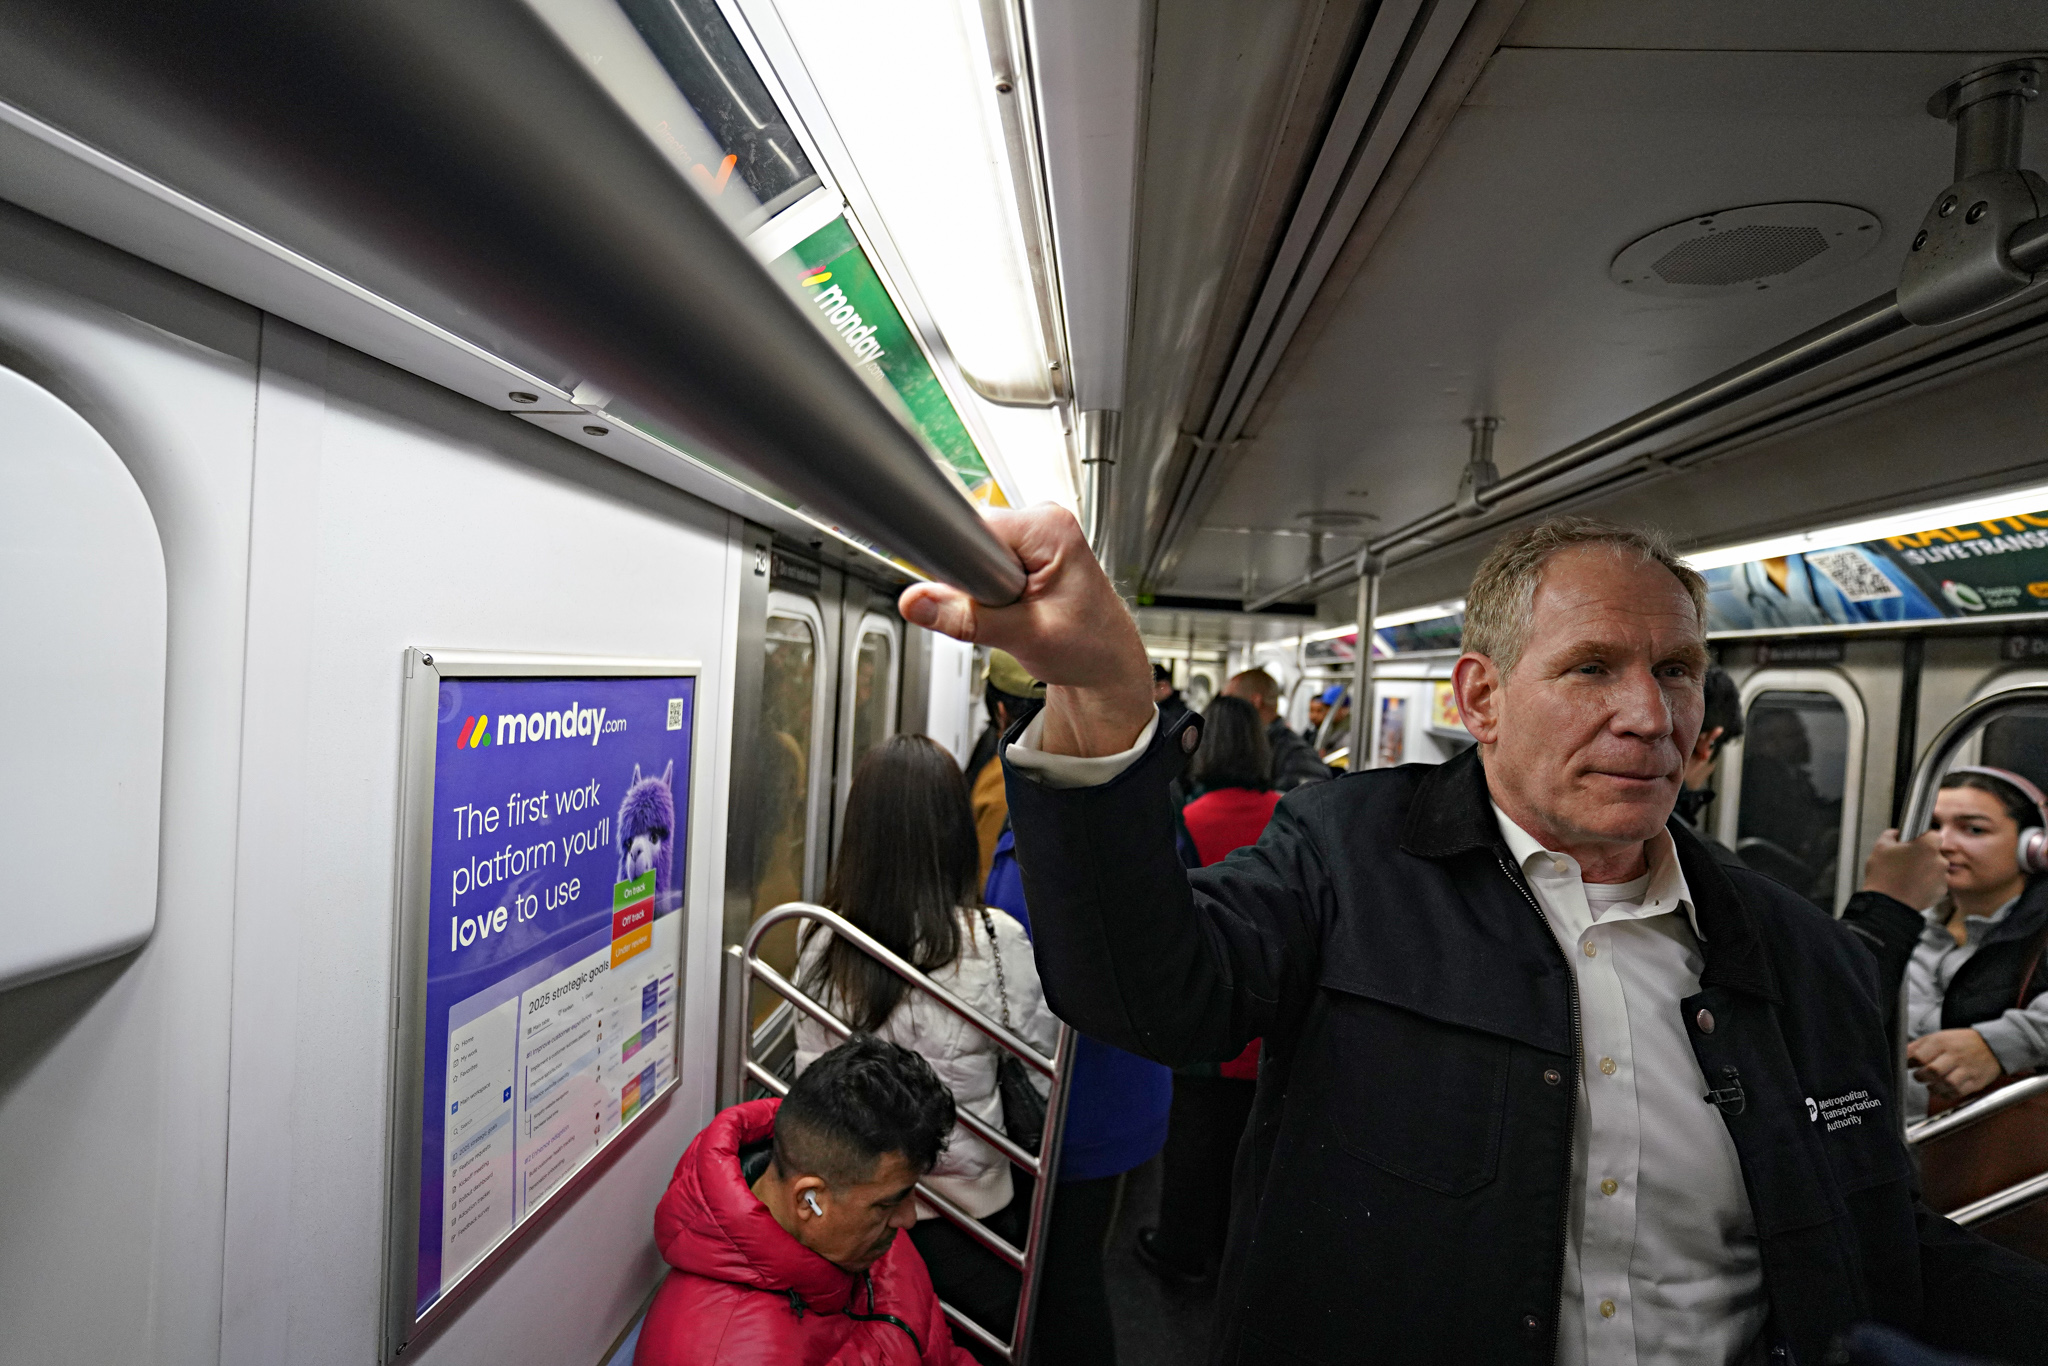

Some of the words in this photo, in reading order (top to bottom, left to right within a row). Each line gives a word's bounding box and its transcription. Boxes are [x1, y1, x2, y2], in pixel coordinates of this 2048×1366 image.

[453, 804, 500, 841] The
[507, 790, 549, 827] first
[555, 778, 600, 815] work
[453, 841, 555, 907] platform
[562, 817, 610, 867] you'll
[624, 889, 632, 899] On
[633, 883, 646, 895] track
[451, 906, 508, 952] love
[515, 893, 538, 923] to
[546, 877, 581, 911] use
[622, 915, 632, 927] Off
[632, 909, 645, 923] track
[615, 942, 631, 958] Under
[631, 935, 648, 949] review
[528, 992, 550, 1015] 2025
[552, 973, 588, 1001] strategic
[588, 960, 609, 983] goals
[461, 1036, 474, 1047] Home
[551, 1027, 570, 1043] customer
[1819, 1090, 1868, 1110] Metropolitan
[1821, 1098, 1882, 1121] Transportation
[1827, 1114, 1862, 1133] Authority
